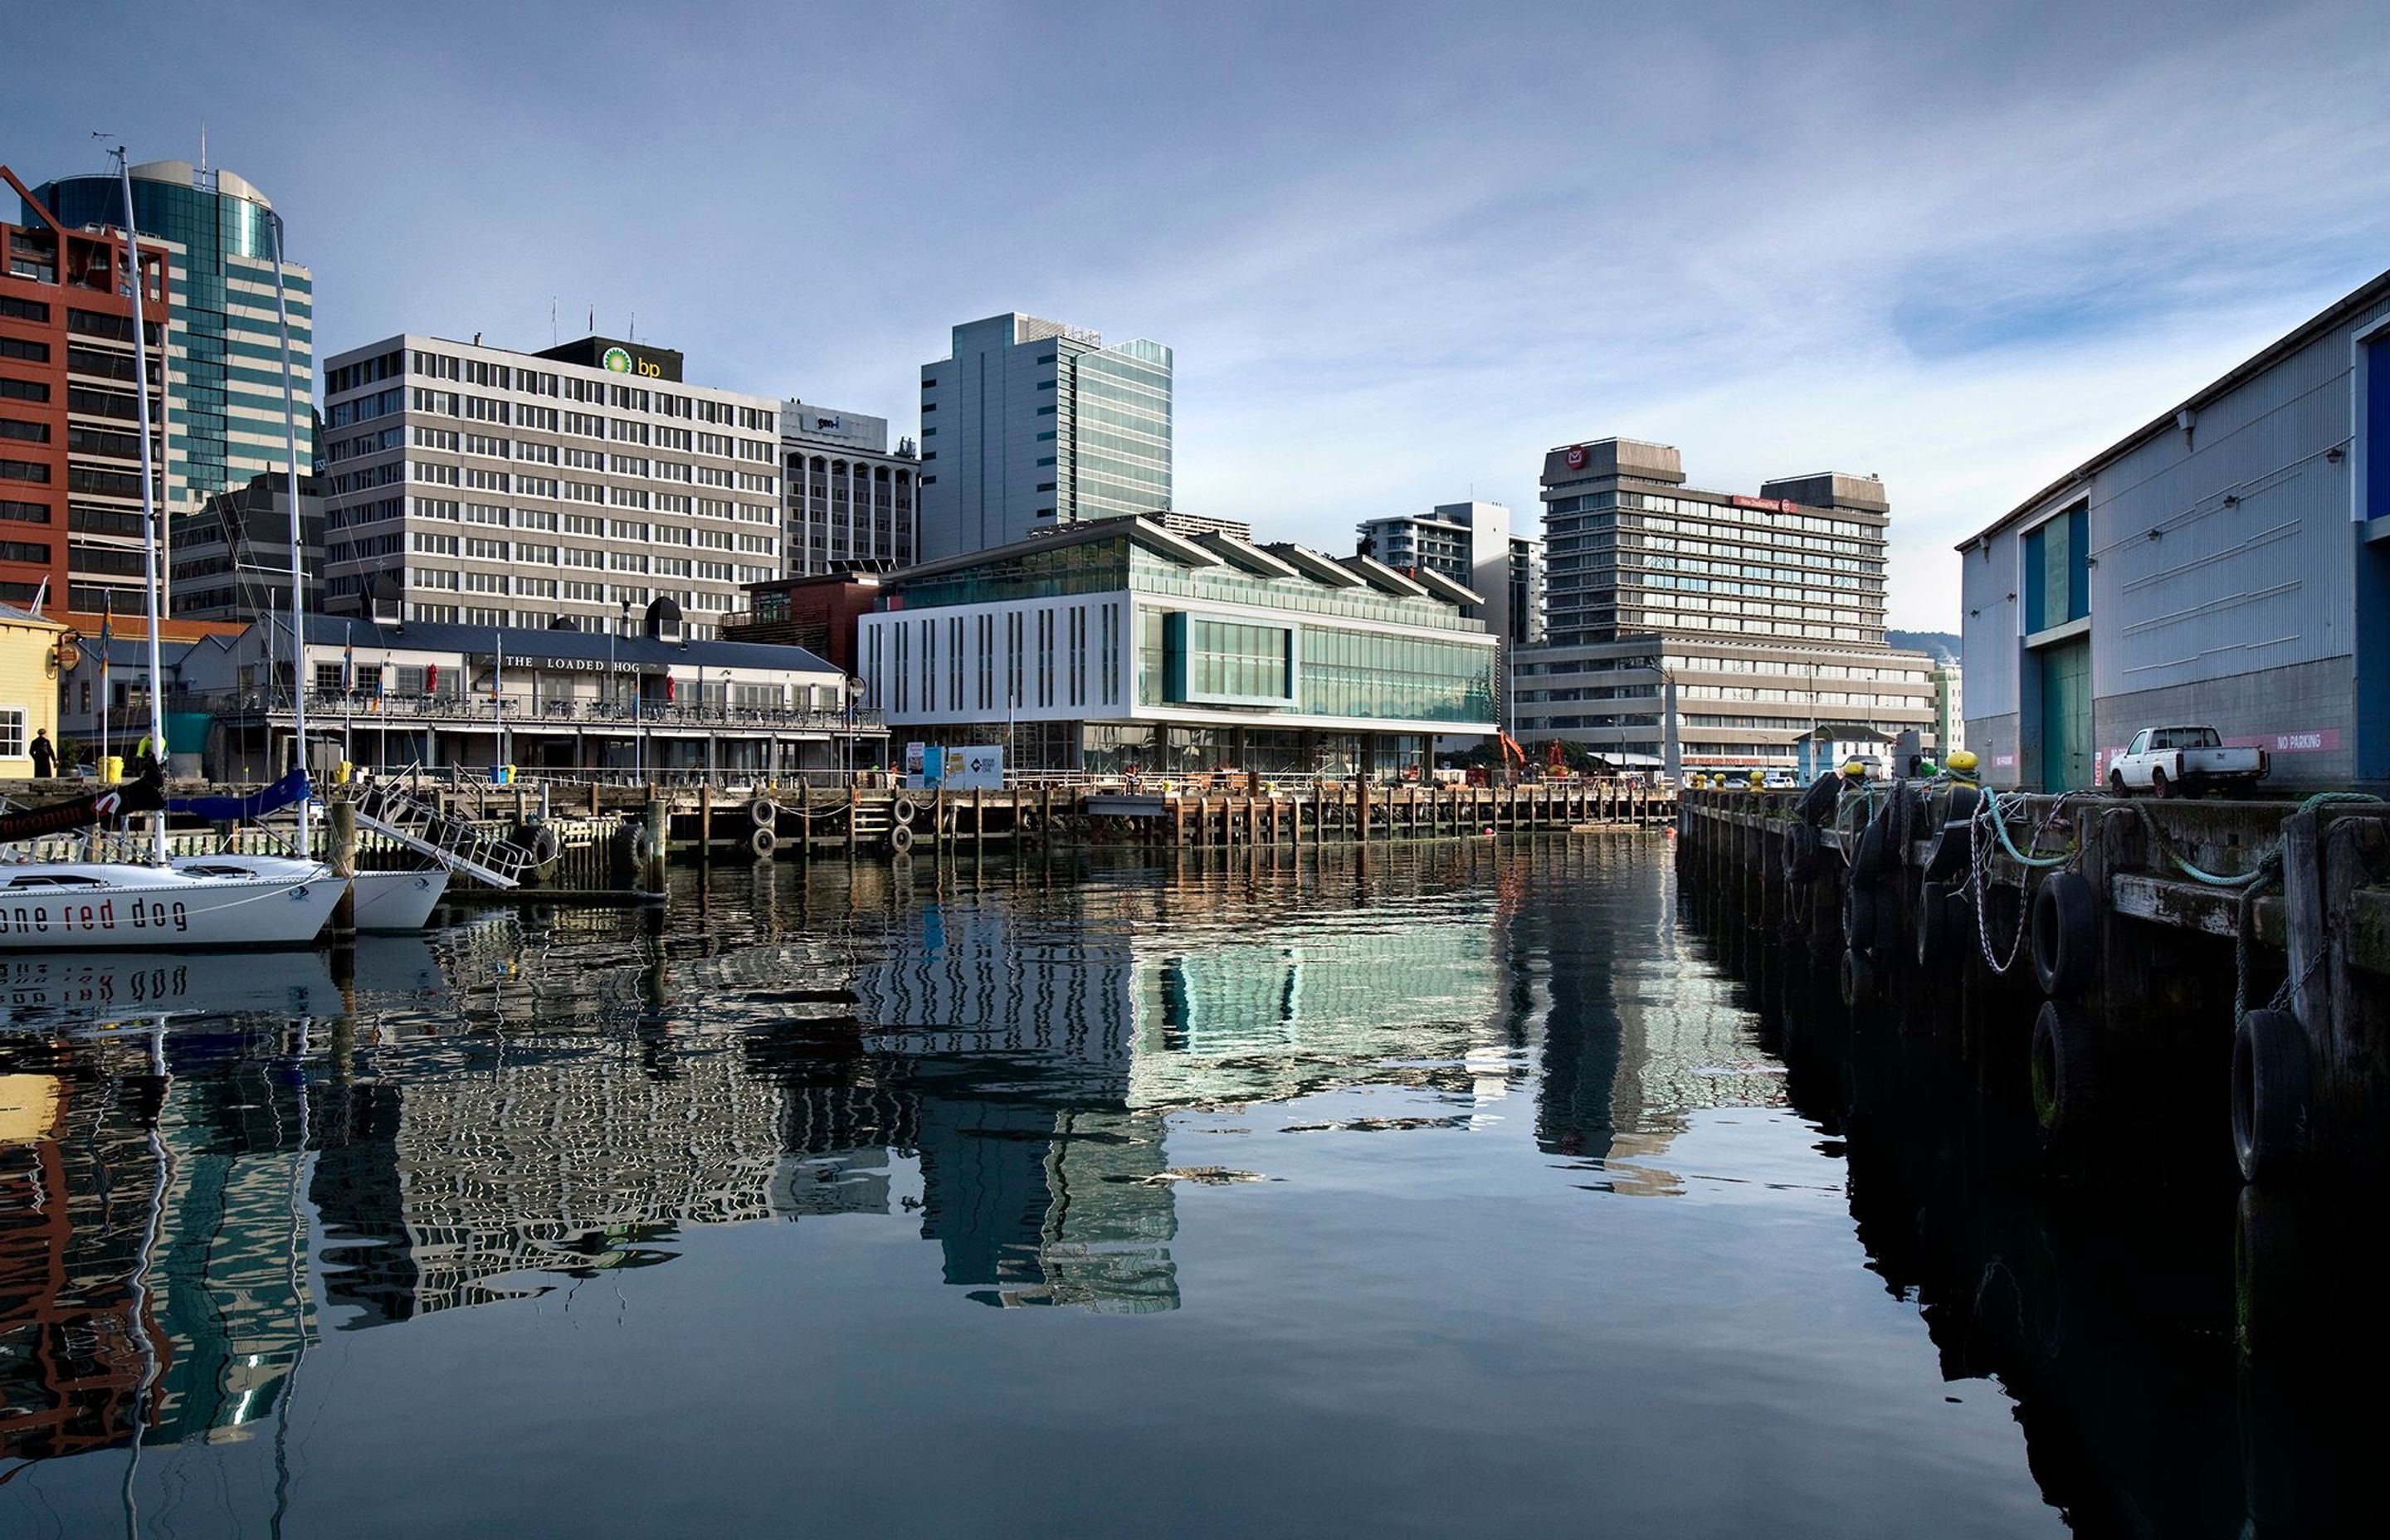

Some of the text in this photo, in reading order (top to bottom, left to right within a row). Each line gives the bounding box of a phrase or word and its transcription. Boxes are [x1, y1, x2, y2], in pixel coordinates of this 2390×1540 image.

[638, 357, 660, 378] bp
[505, 655, 640, 673] THE LOADED HOG
[2277, 733, 2321, 750] NO PARKING
[0, 897, 188, 933] one red dog
